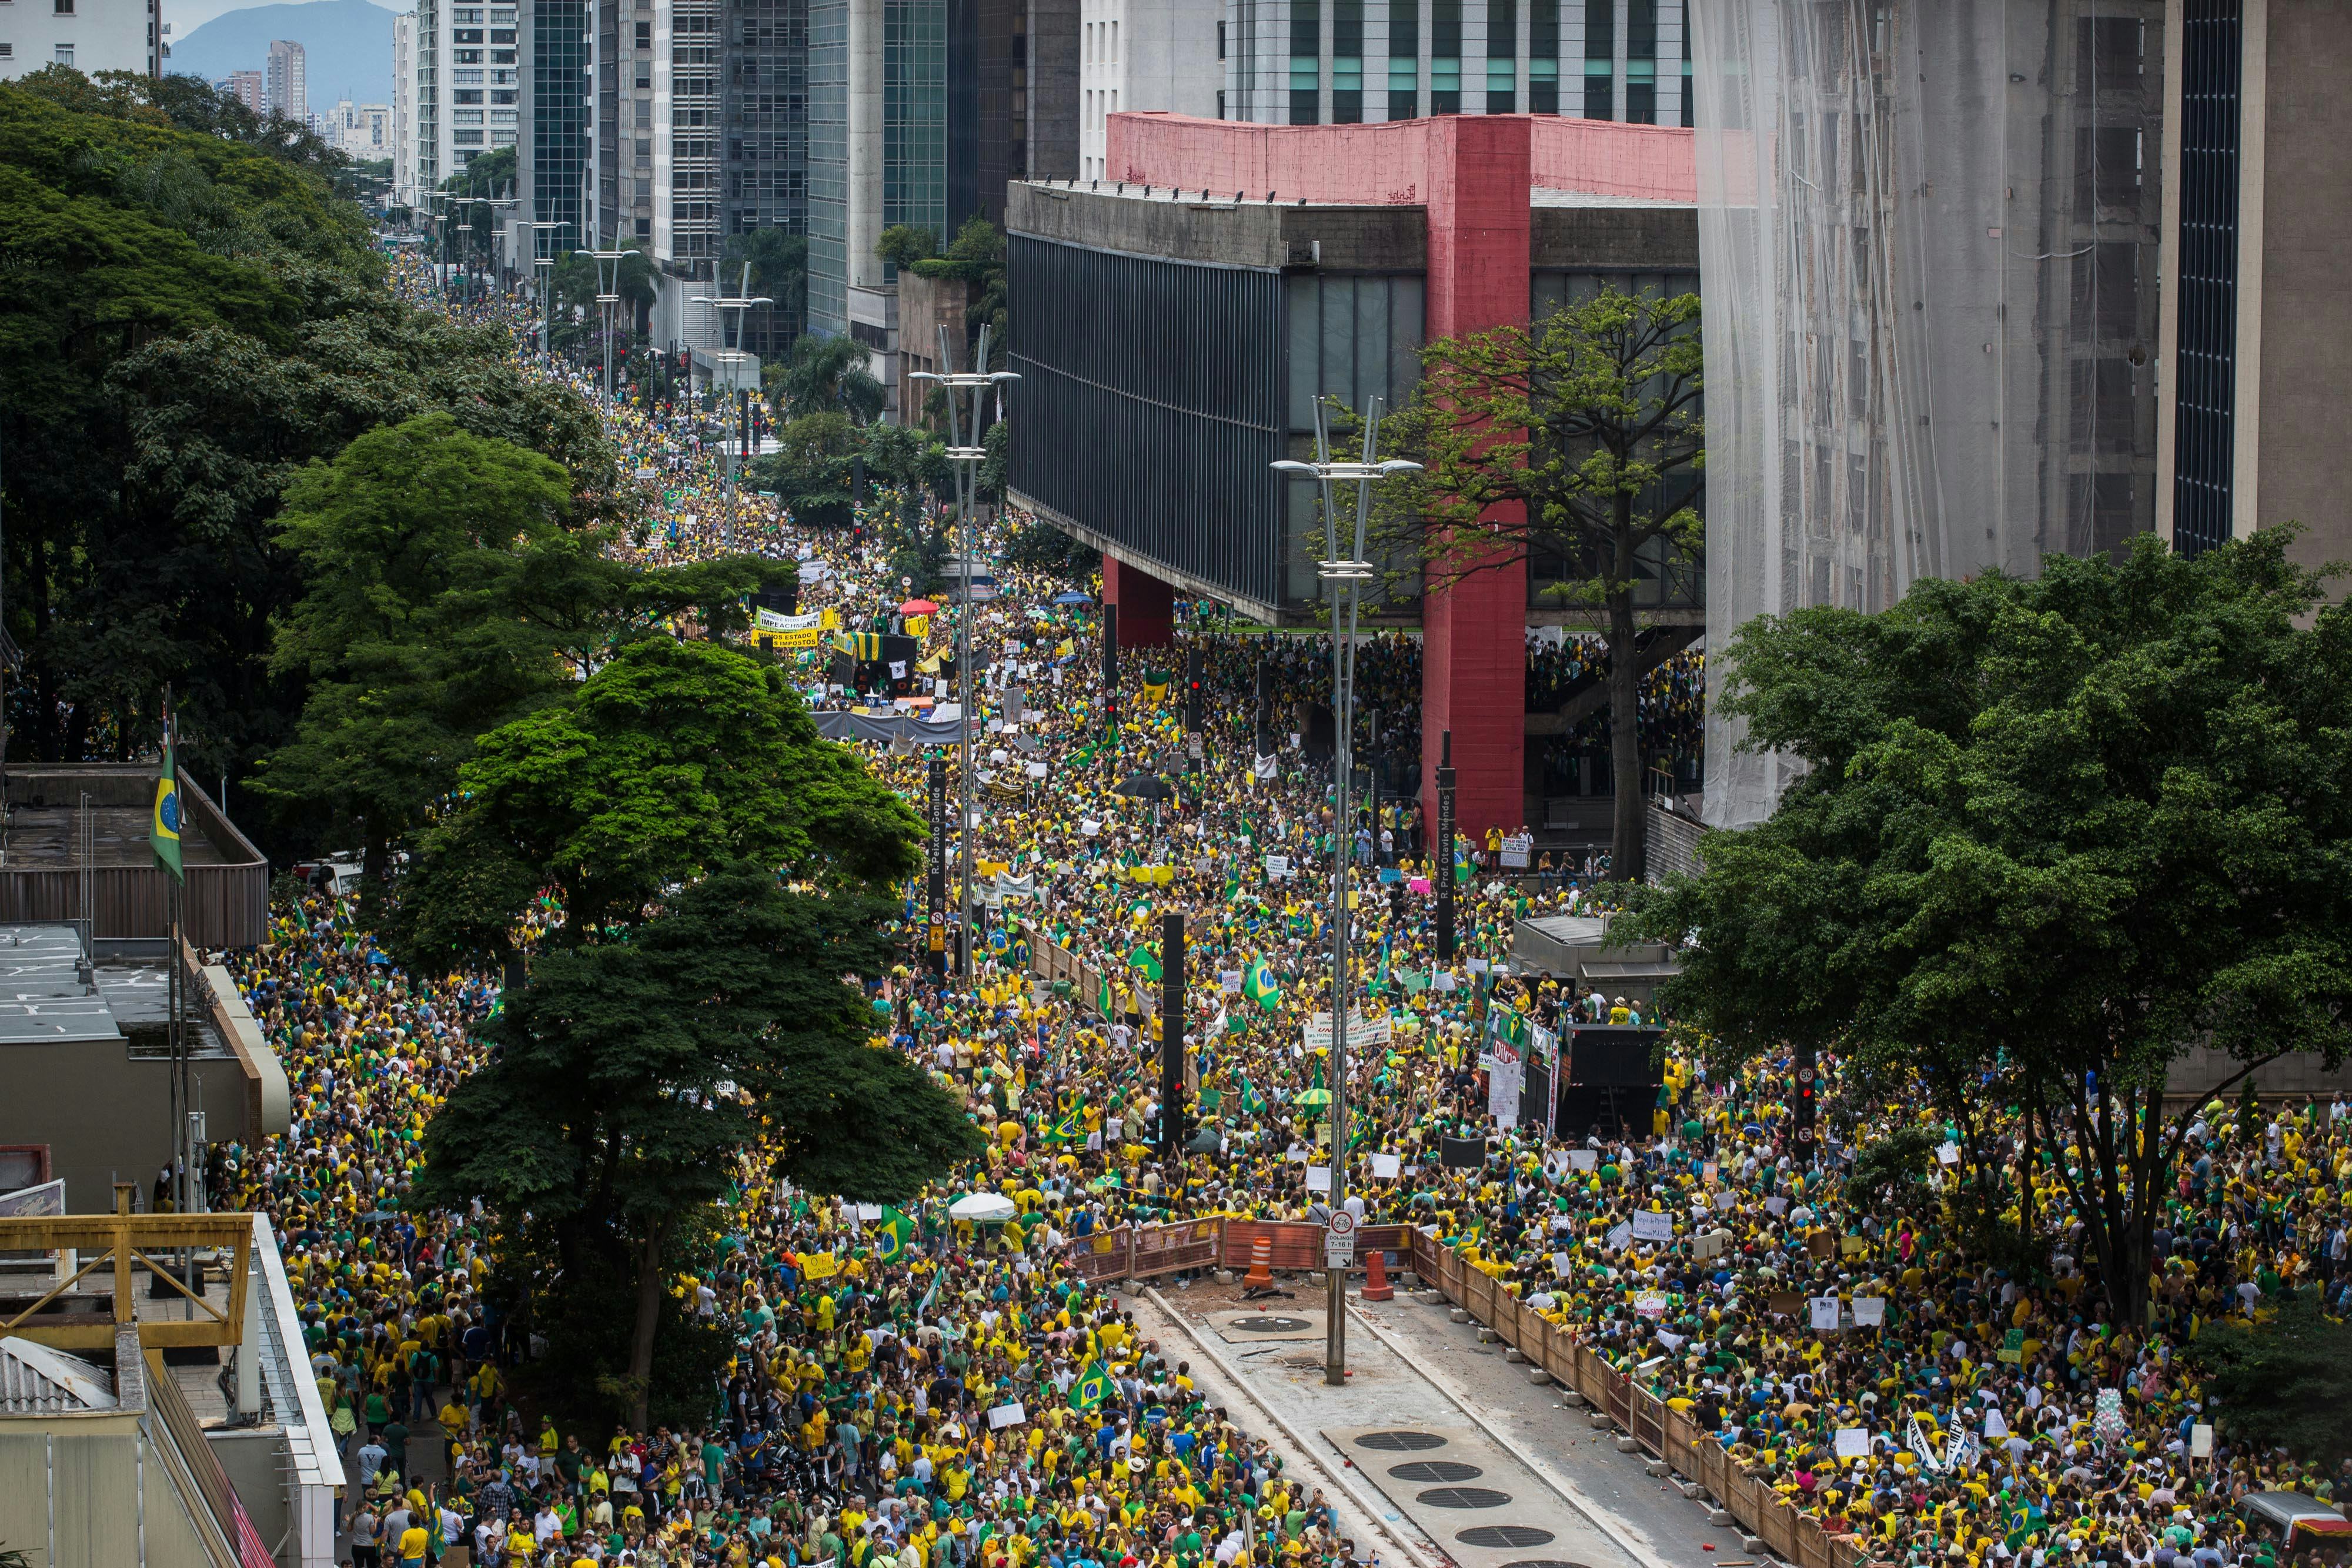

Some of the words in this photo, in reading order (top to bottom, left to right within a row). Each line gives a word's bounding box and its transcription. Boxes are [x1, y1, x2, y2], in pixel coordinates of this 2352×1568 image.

[761, 612, 778, 620] POBRES
[761, 618, 818, 628] IMPEACHMENT
[1441, 795, 1450, 830] Mendes
[932, 827, 940, 863] Peixoto
[932, 865, 940, 874] R.
[1441, 866, 1449, 888] Prof.
[1441, 890, 1449, 899] R.
[1613, 1013, 1626, 1022] 53
[1495, 1040, 1518, 1063] Dilma
[1801, 1070, 1812, 1078] 50
[811, 1257, 818, 1266] O
[821, 1255, 831, 1265] PT
[807, 1266, 836, 1278] ACABOU
[854, 1356, 863, 1367] 10
[365, 1453, 376, 1466] Y
